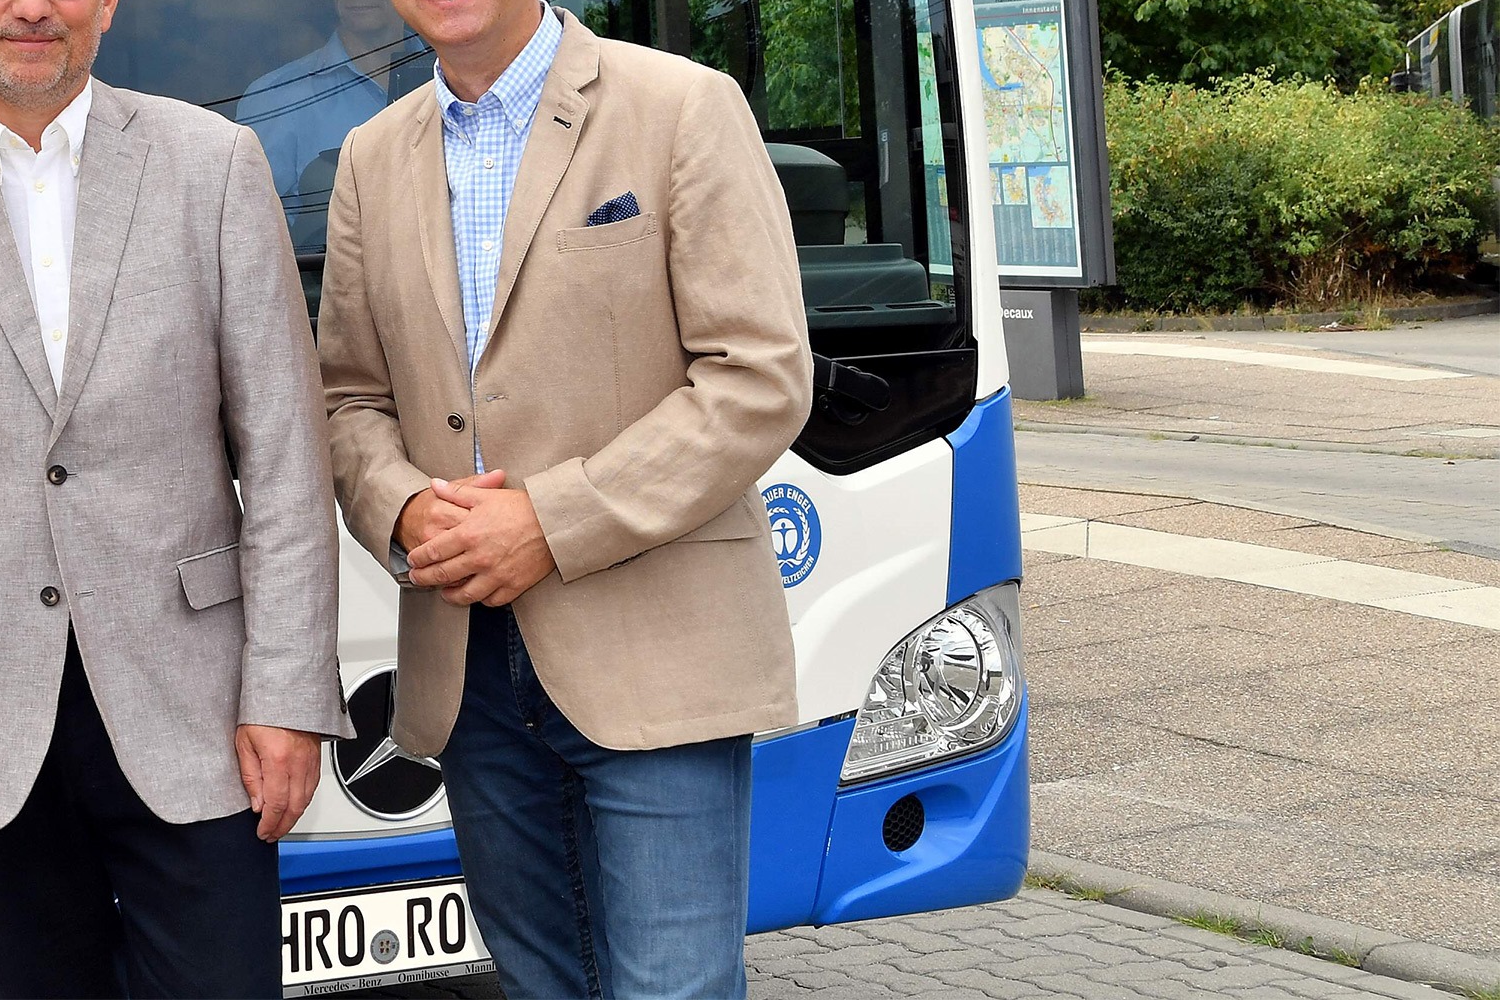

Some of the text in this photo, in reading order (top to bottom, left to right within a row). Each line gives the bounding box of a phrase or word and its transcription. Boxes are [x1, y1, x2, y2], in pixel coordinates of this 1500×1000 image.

[1022, 6, 1058, 14] Innenstadt
[786, 487, 813, 514] ENGEL
[782, 555, 815, 584] ELTZEICHEN
[282, 893, 466, 973] HRO RO
[303, 981, 350, 996] Mercedes
[358, 976, 382, 989] Benz
[397, 968, 450, 984] Omnibusse
